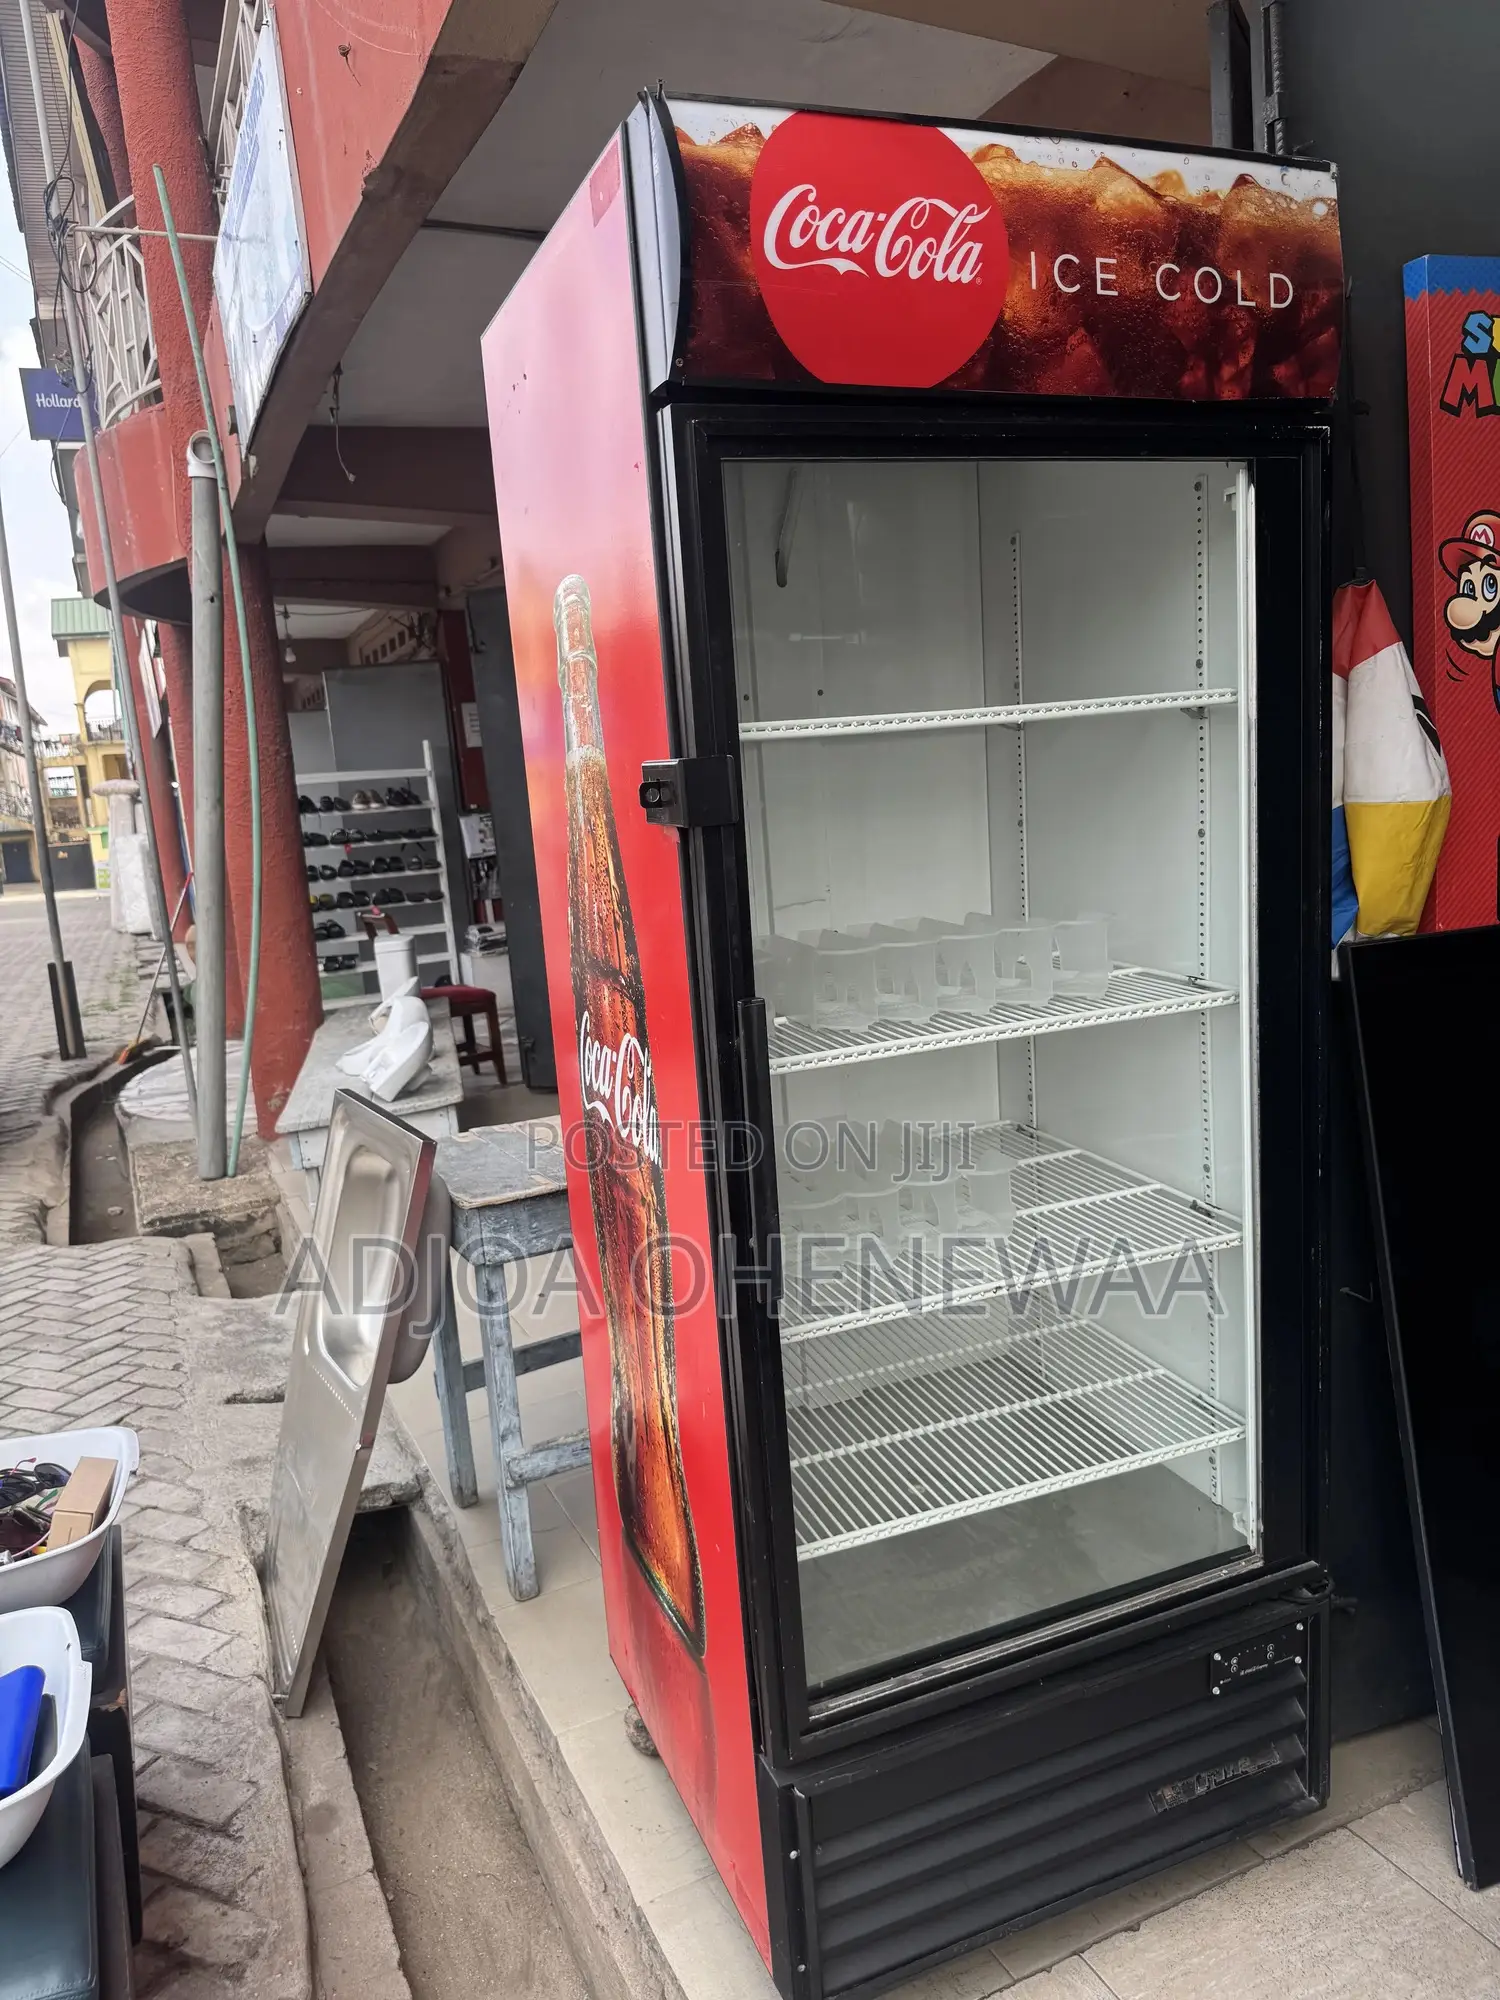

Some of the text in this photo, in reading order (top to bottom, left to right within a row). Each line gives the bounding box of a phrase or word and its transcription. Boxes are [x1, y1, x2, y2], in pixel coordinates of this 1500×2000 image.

[1030, 251, 1294, 310] ICE COLD
[1461, 310, 1500, 358] S
[1440, 353, 1500, 418] M
